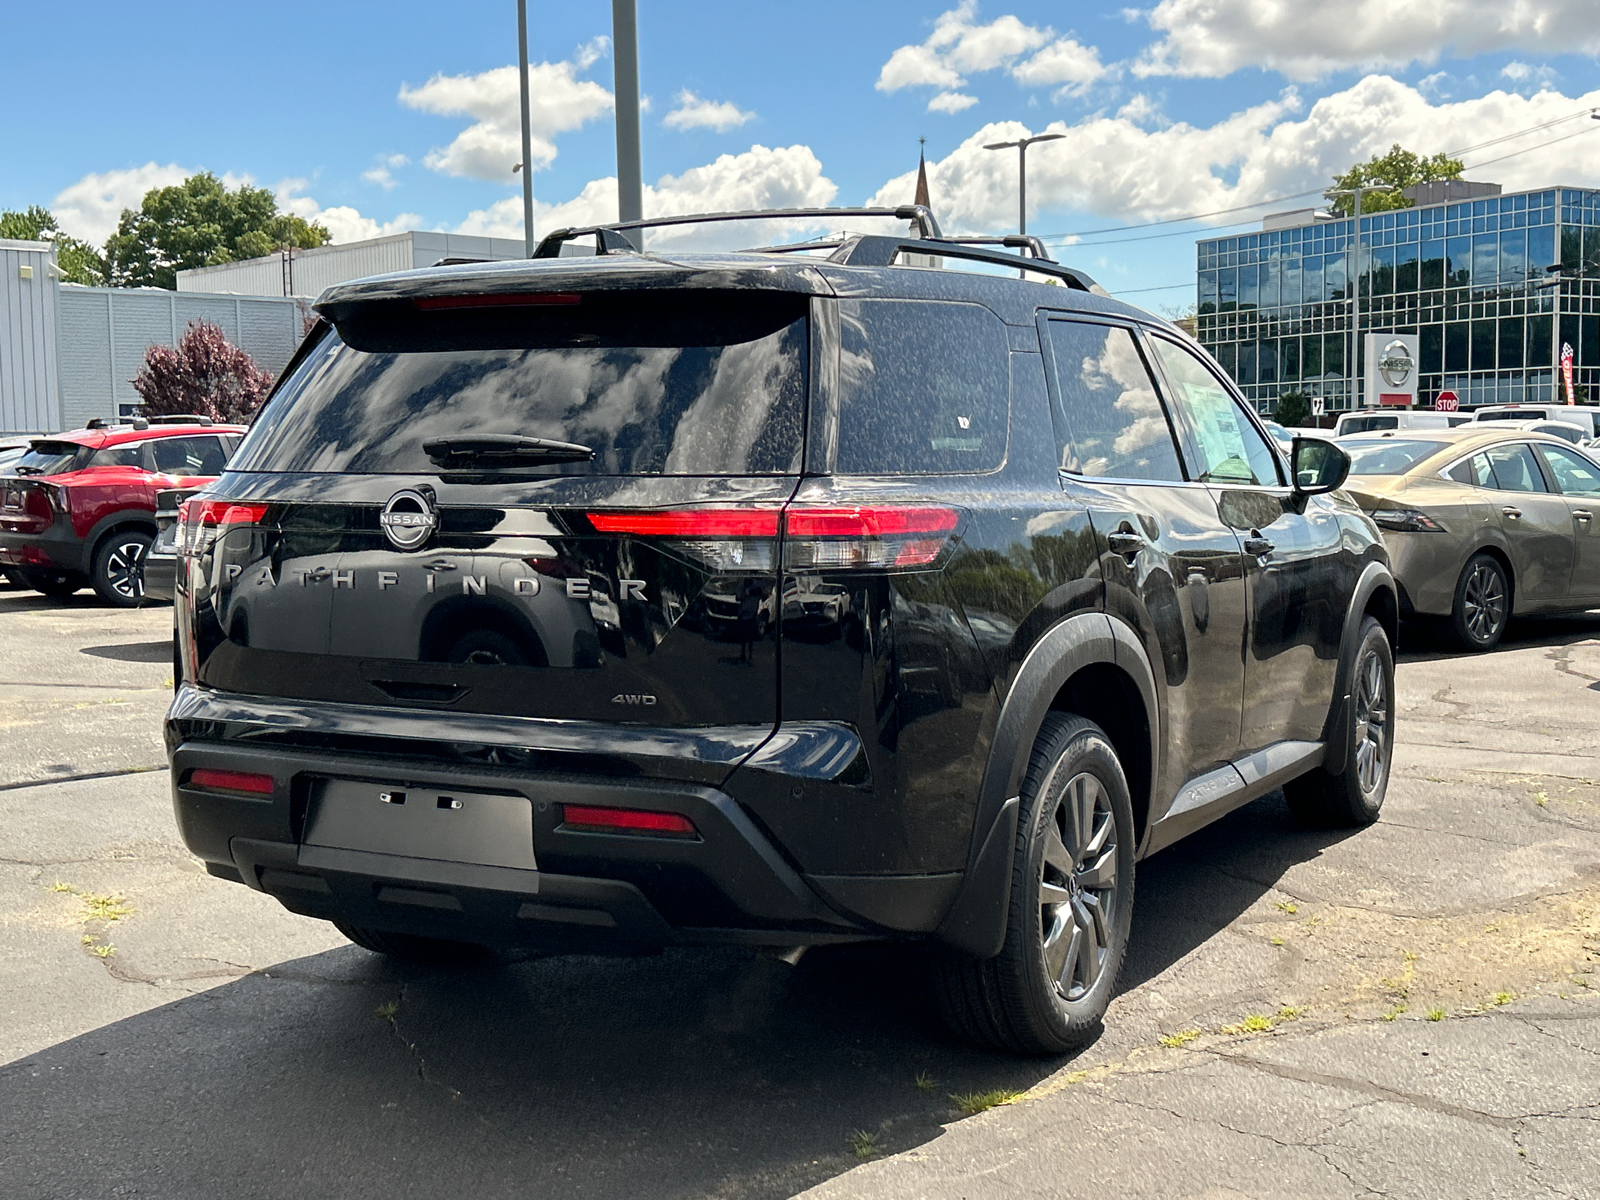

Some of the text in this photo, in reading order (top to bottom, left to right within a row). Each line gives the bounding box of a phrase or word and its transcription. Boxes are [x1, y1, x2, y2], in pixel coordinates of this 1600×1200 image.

[1383, 360, 1413, 369] NISSAN
[1437, 399, 1458, 411] STOP
[380, 514, 431, 525] NISSAN
[224, 563, 648, 602] PATHFINDER
[611, 694, 657, 705] 4WD
